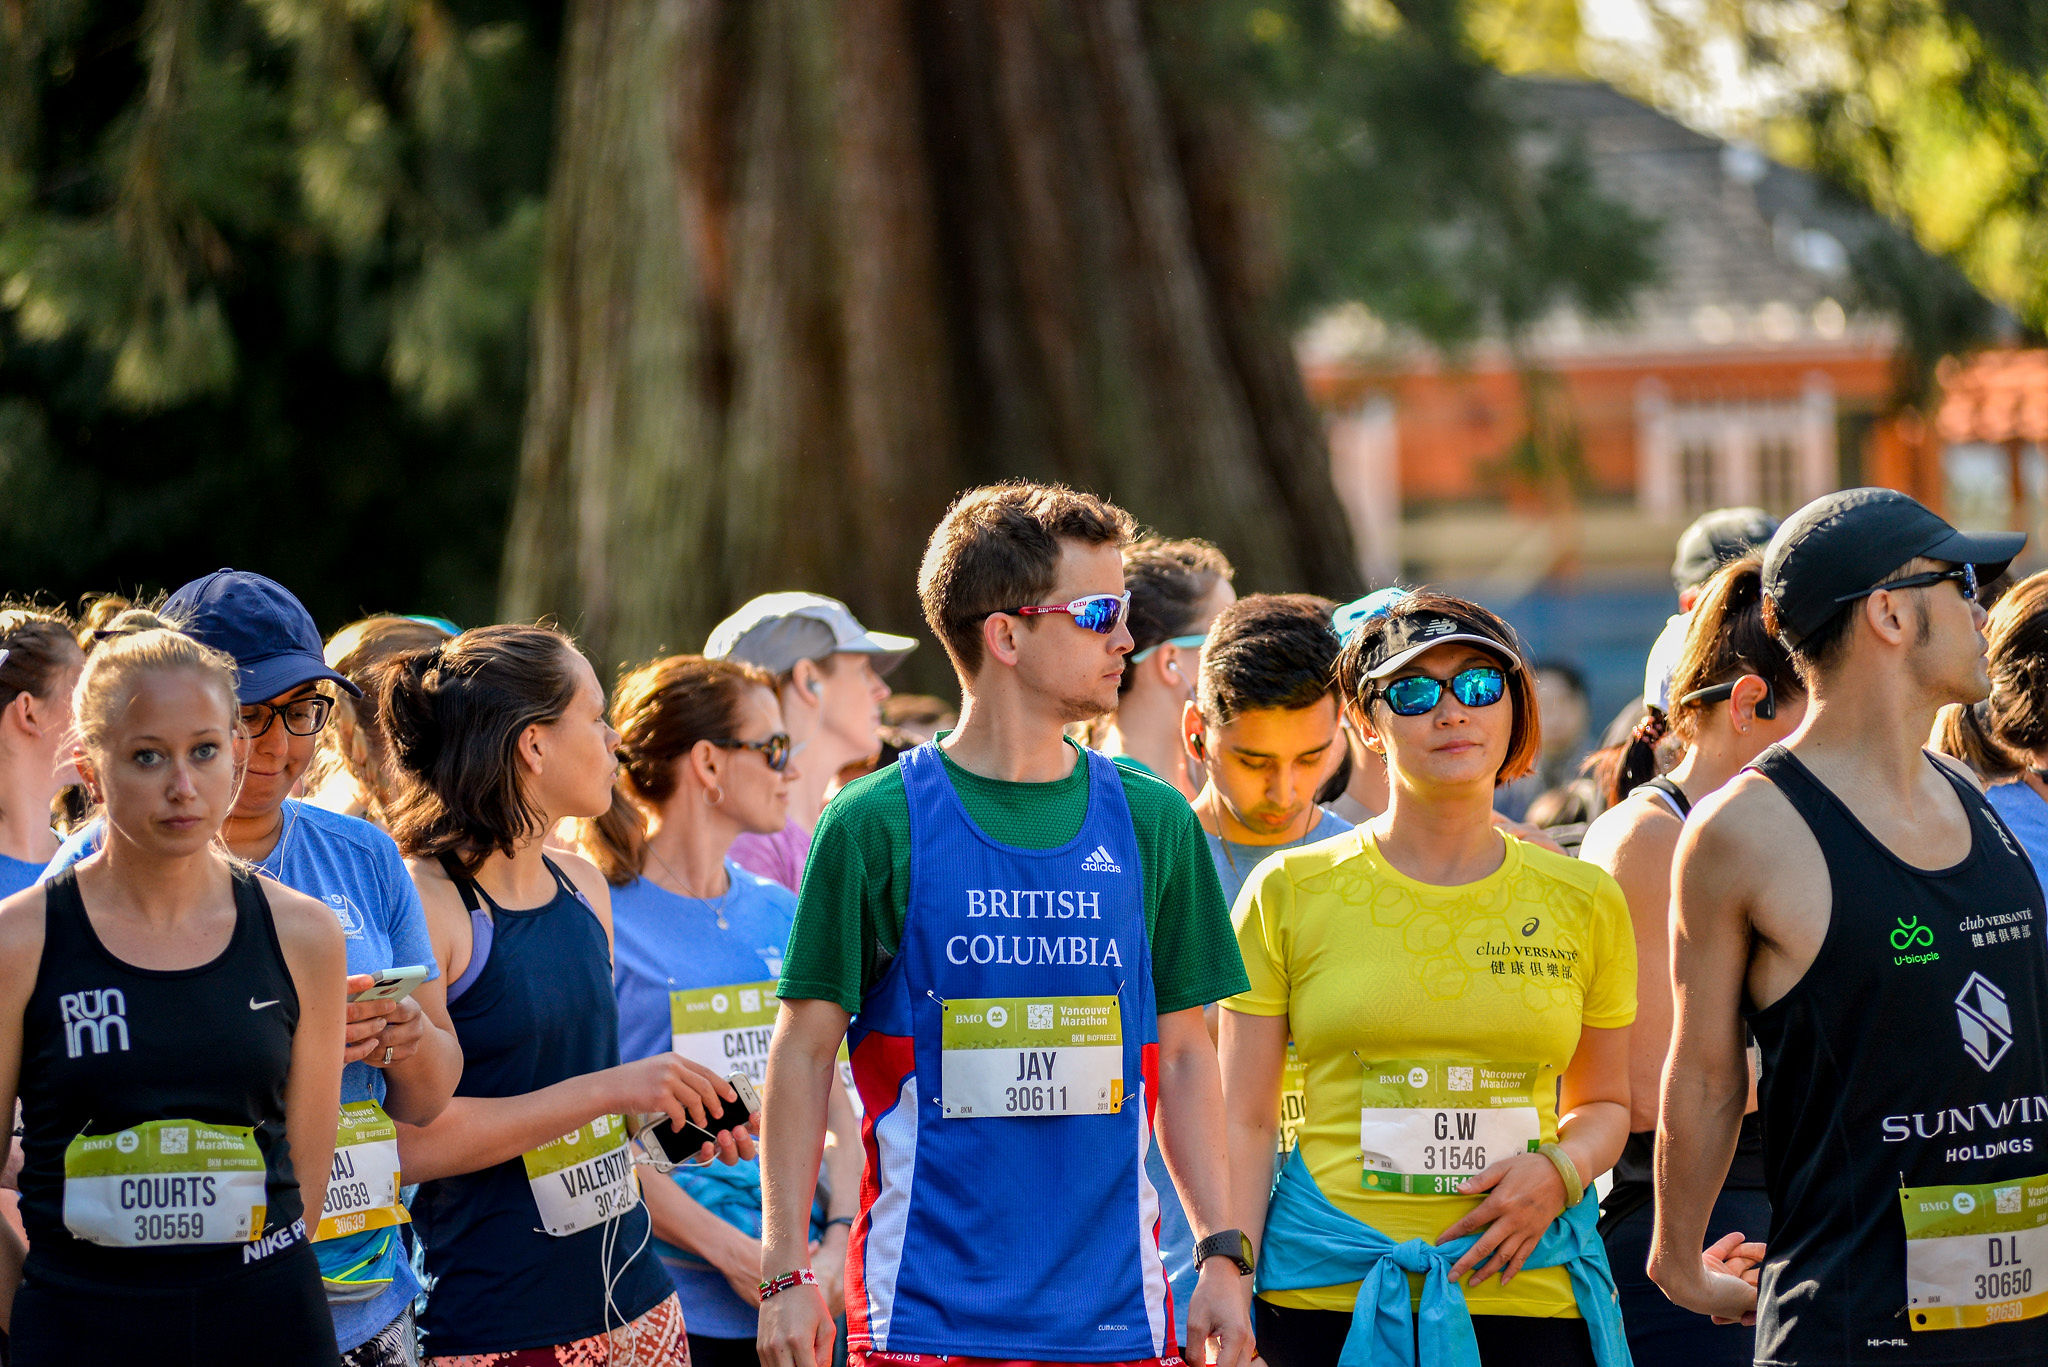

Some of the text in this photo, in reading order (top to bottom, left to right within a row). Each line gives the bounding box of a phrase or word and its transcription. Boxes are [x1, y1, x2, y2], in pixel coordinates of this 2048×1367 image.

[1081, 861, 1121, 873] adidas
[966, 889, 1101, 919] BRITISH
[1959, 915, 1984, 932] club
[946, 934, 1122, 967] COLUMBIA
[1476, 941, 1511, 956] club
[1895, 951, 1940, 966] U-bicycle
[955, 1014, 983, 1024] BMO
[1060, 1006, 1111, 1016] Vancouver
[1060, 1016, 1108, 1026] Marathon
[1071, 1034, 1085, 1043] 8KM
[1017, 1051, 1056, 1081] JAY
[1379, 1074, 1405, 1084] BMO
[1480, 1069, 1527, 1080] Vancouver
[1006, 1086, 1067, 1112] 30611
[961, 1106, 972, 1114] 8KM
[1434, 1112, 1477, 1141] G.W
[82, 1140, 112, 1151] BMO
[195, 1140, 245, 1151] Marathon
[1946, 1138, 2034, 1163] HOLDINGS
[1424, 1145, 1486, 1170] 31546
[121, 1176, 216, 1210] COURTS
[1434, 1177, 1472, 1193] 315
[1920, 1201, 1950, 1212] BMO
[135, 1212, 204, 1241] 30559
[333, 1213, 366, 1235] 30639
[243, 1227, 294, 1265] NIKE
[1989, 1236, 2022, 1268] D.L
[1975, 1268, 2032, 1300] 30650
[1986, 1301, 2023, 1323] 30650
[884, 1353, 920, 1363] LIONS
